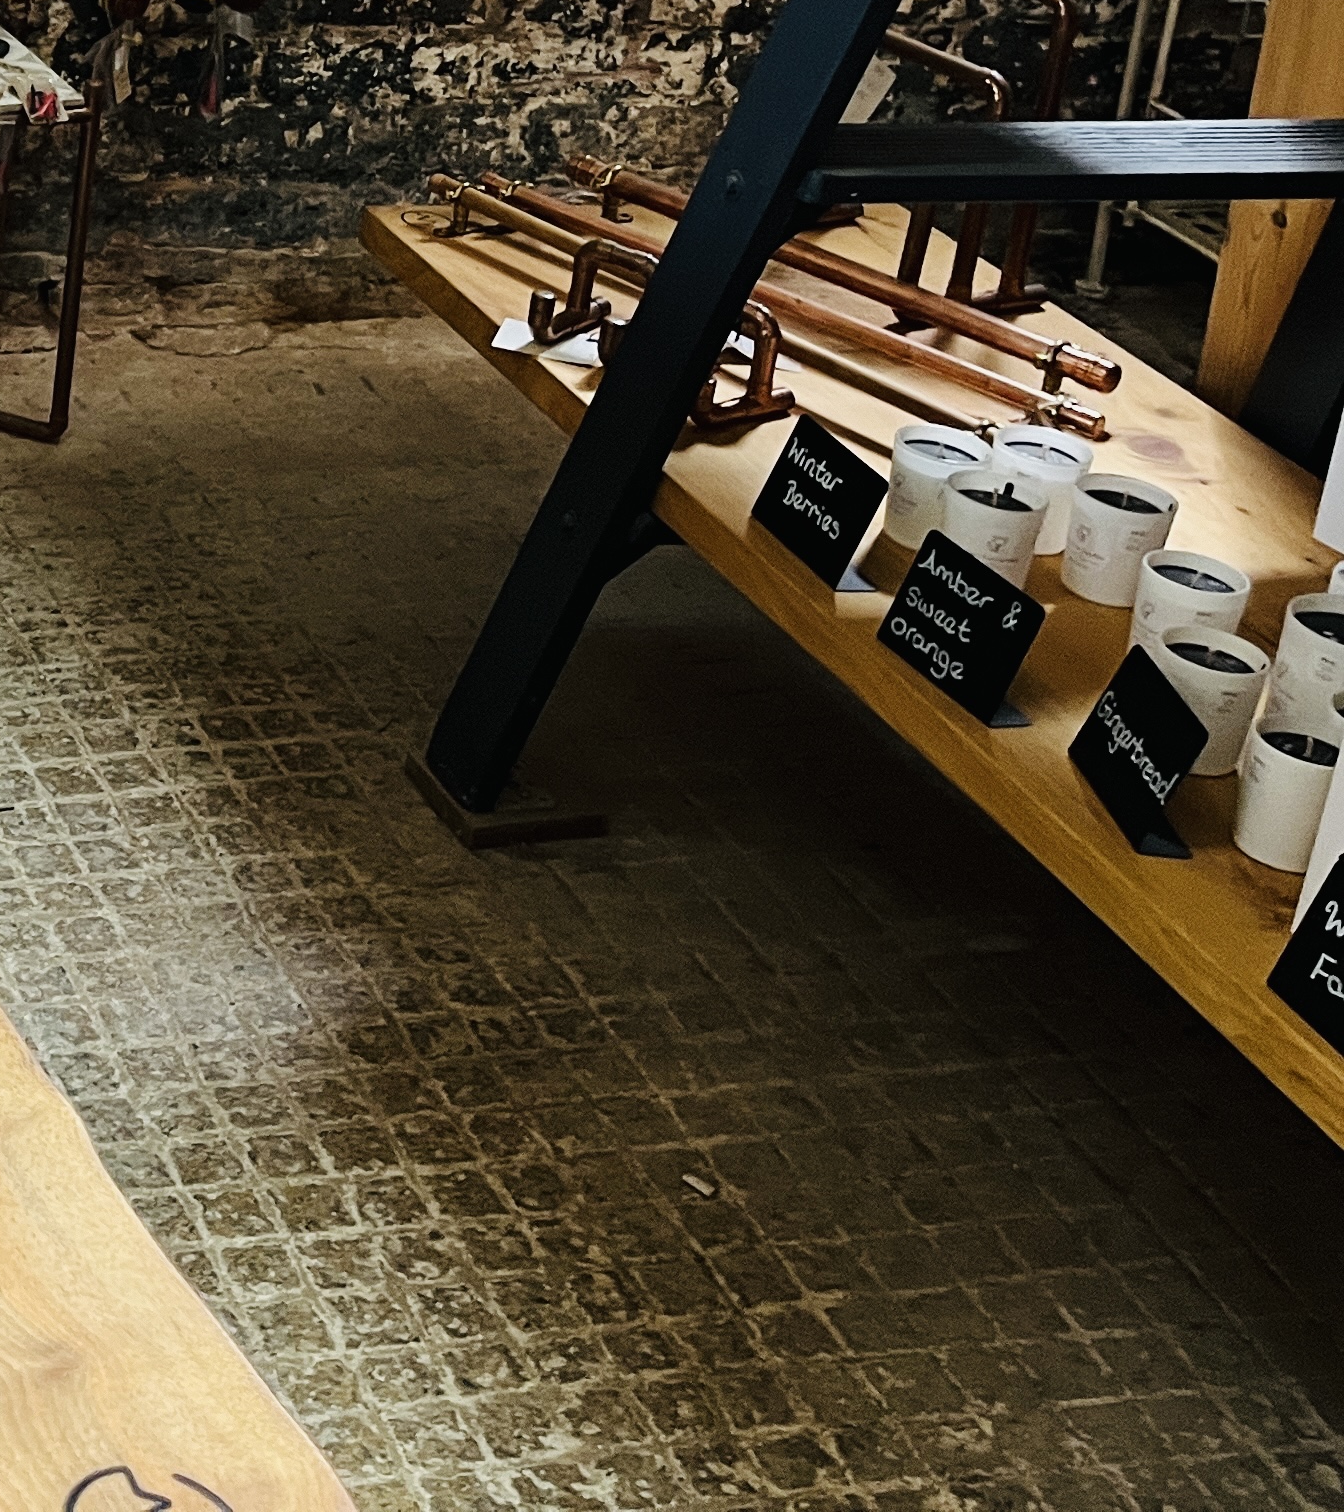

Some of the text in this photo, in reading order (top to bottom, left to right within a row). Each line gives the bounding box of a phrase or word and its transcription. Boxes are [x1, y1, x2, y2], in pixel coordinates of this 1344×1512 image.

[787, 436, 843, 491] Winter
[782, 480, 840, 540] Berries
[906, 586, 972, 643] Sweet
[918, 548, 1022, 631] Amber &
[890, 616, 965, 681] Orange
[1097, 690, 1180, 806] Gingerbread
